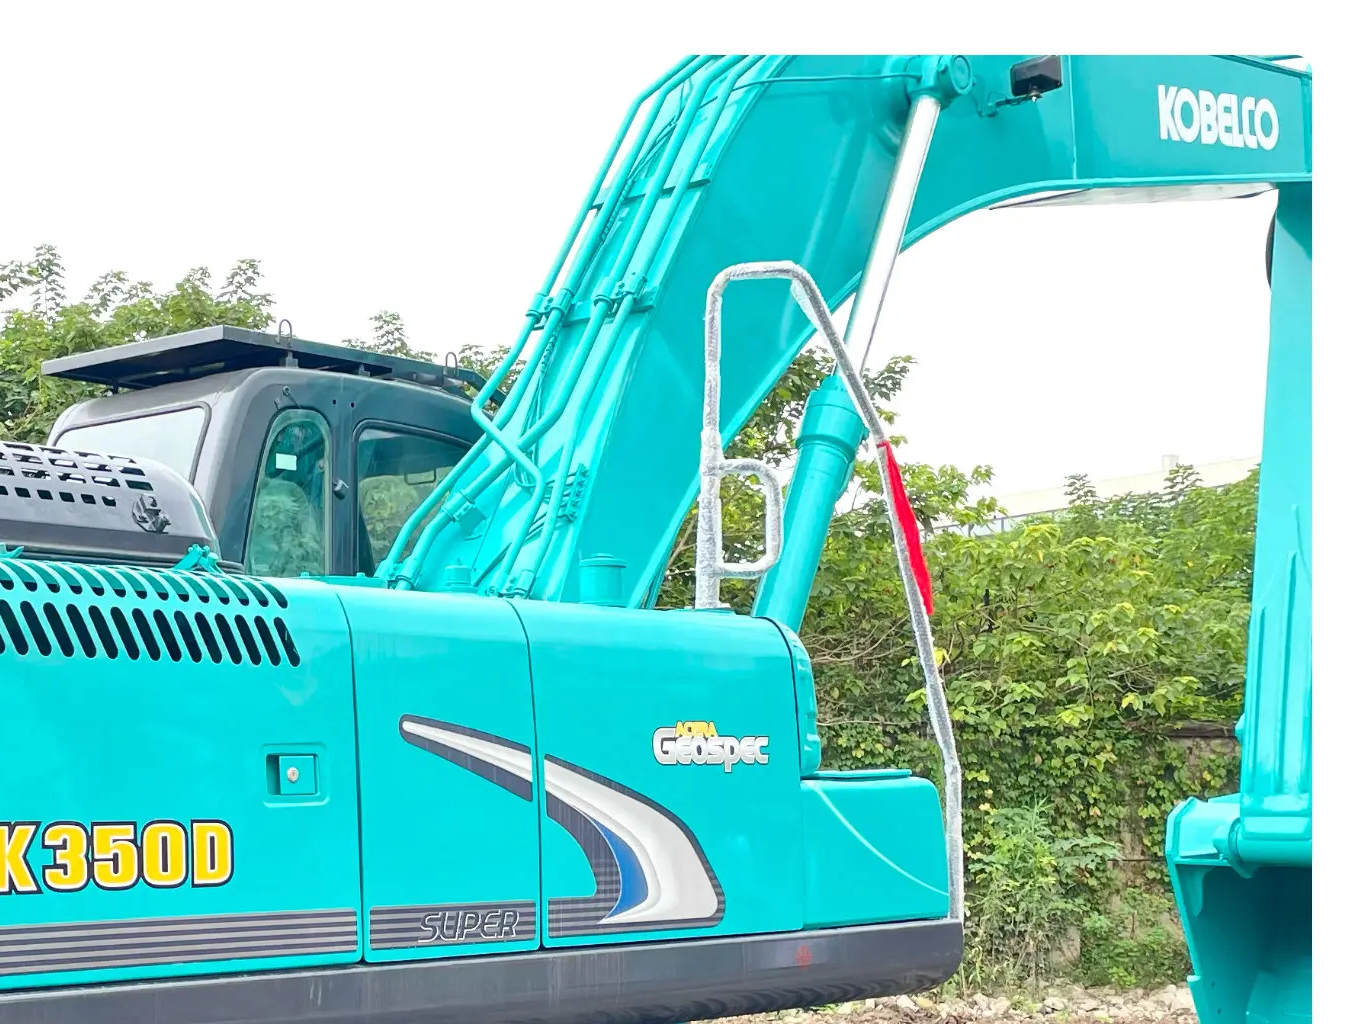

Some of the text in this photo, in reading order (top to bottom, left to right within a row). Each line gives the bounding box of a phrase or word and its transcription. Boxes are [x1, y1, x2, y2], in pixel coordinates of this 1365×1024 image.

[1157, 84, 1279, 151] KOBELCO
[652, 727, 769, 773] Geospec
[417, 909, 519, 943] SUPER
